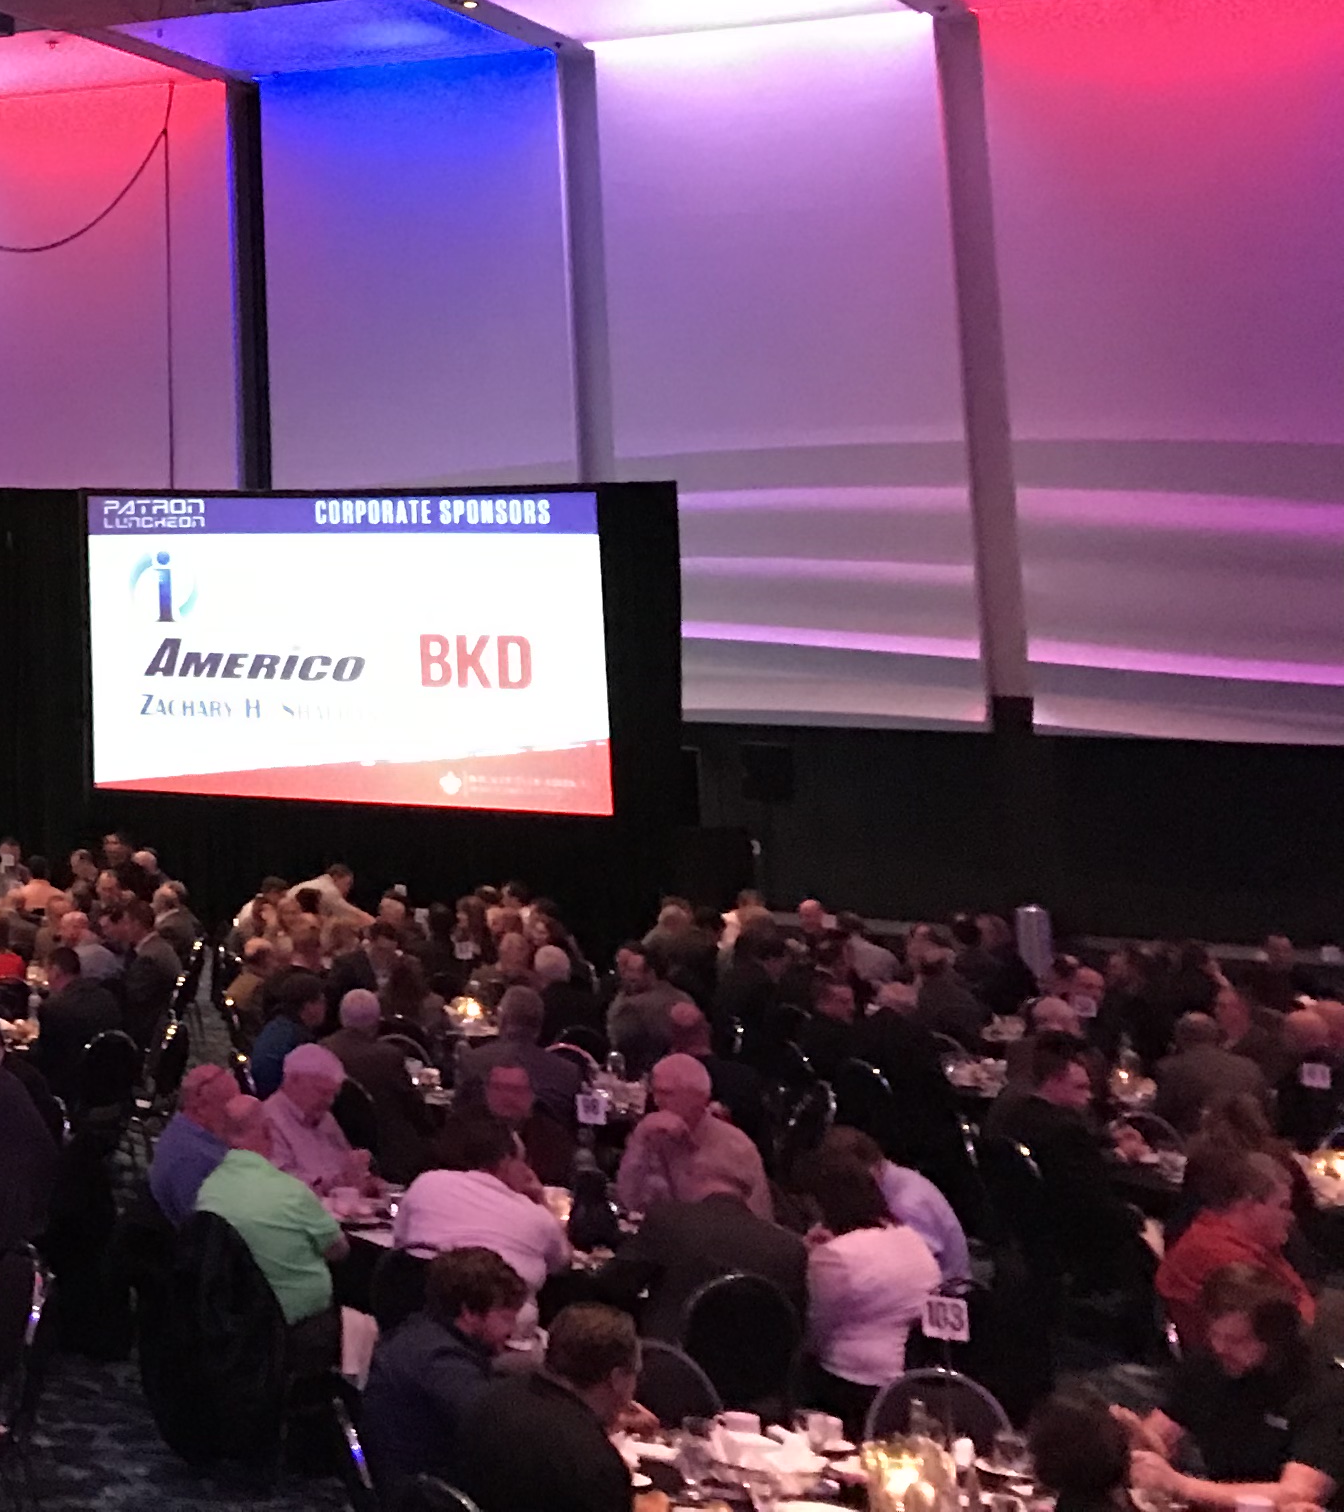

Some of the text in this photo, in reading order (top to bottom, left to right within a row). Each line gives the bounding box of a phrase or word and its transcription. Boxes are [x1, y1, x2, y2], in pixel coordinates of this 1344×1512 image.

[103, 498, 205, 515] PATRON
[314, 498, 552, 525] CORPORATE SPONSORS
[103, 516, 206, 529] LUNCHEON
[418, 633, 533, 690] BKD
[926, 1300, 964, 1332] 103
